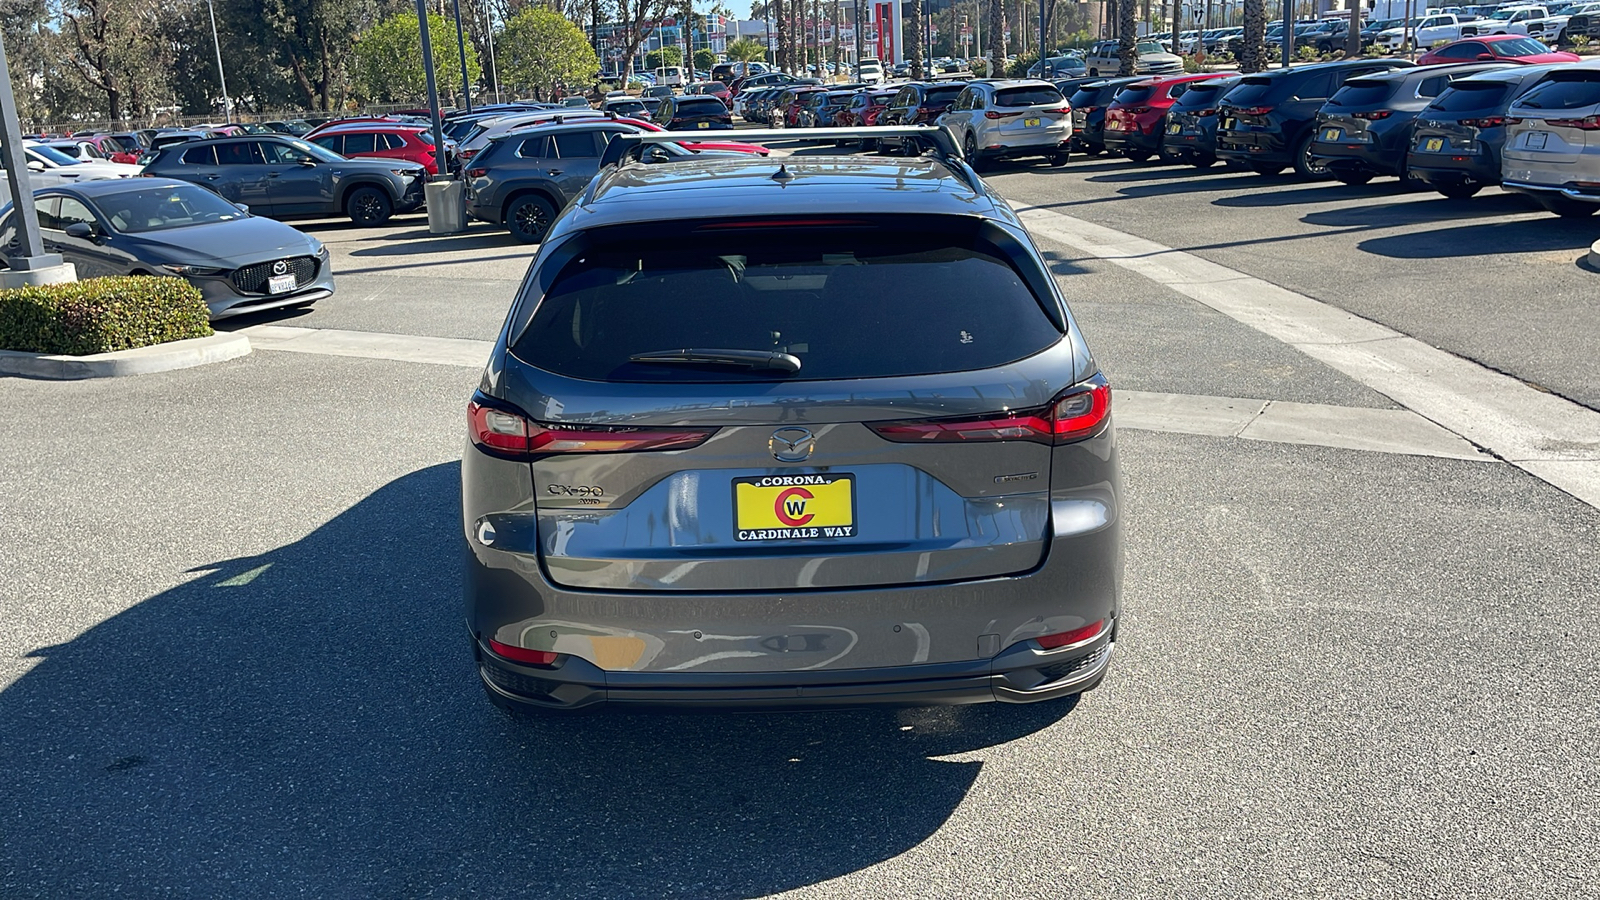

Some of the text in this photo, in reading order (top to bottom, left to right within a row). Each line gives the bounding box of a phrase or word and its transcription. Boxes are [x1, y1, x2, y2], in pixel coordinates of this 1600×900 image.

[761, 475, 824, 486] CORONA
[547, 484, 604, 497] CX-90
[738, 526, 853, 540] CARDINALE WAY
